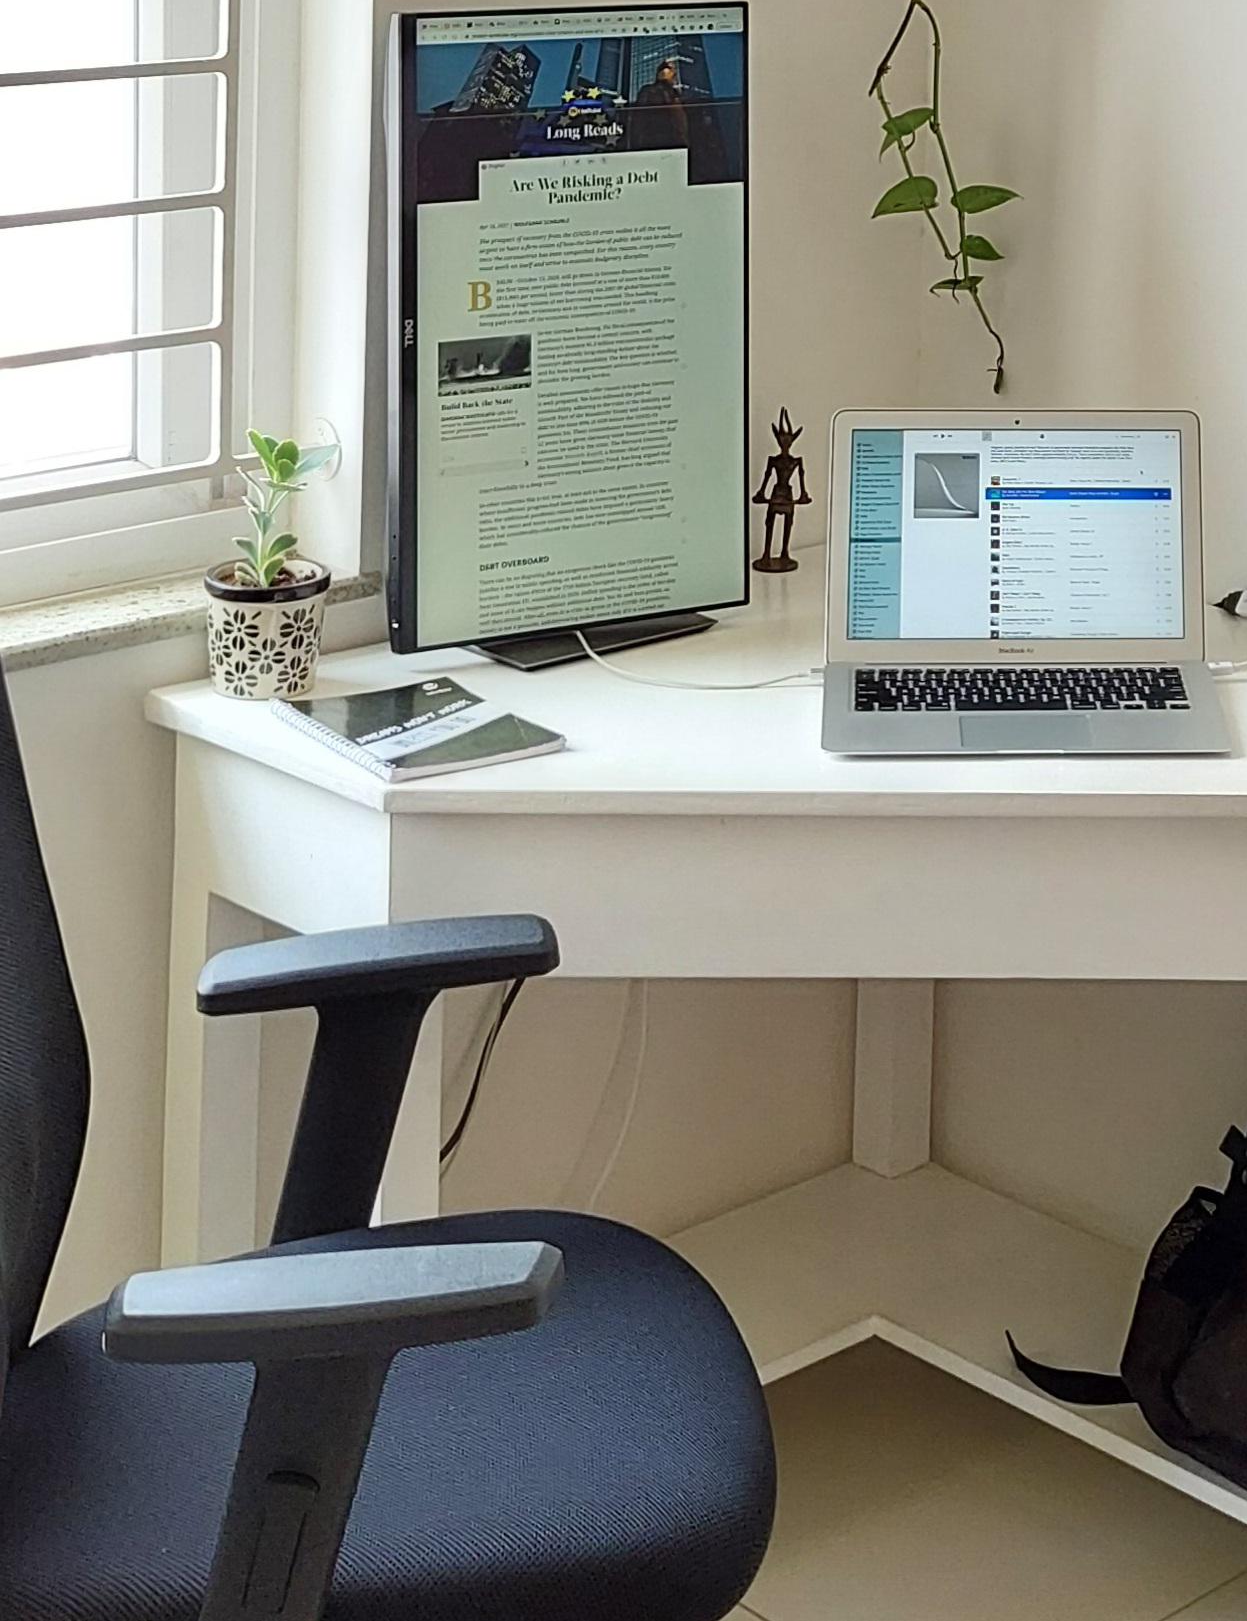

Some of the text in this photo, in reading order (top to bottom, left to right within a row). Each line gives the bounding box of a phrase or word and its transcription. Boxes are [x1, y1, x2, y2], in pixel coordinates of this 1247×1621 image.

[547, 122, 624, 140] Long Reads
[510, 171, 659, 192] Are We Risking a Debt
[548, 187, 622, 205] Pandemic?
[404, 318, 414, 349] DELL
[479, 555, 550, 572] DEBT OVERBOARD
